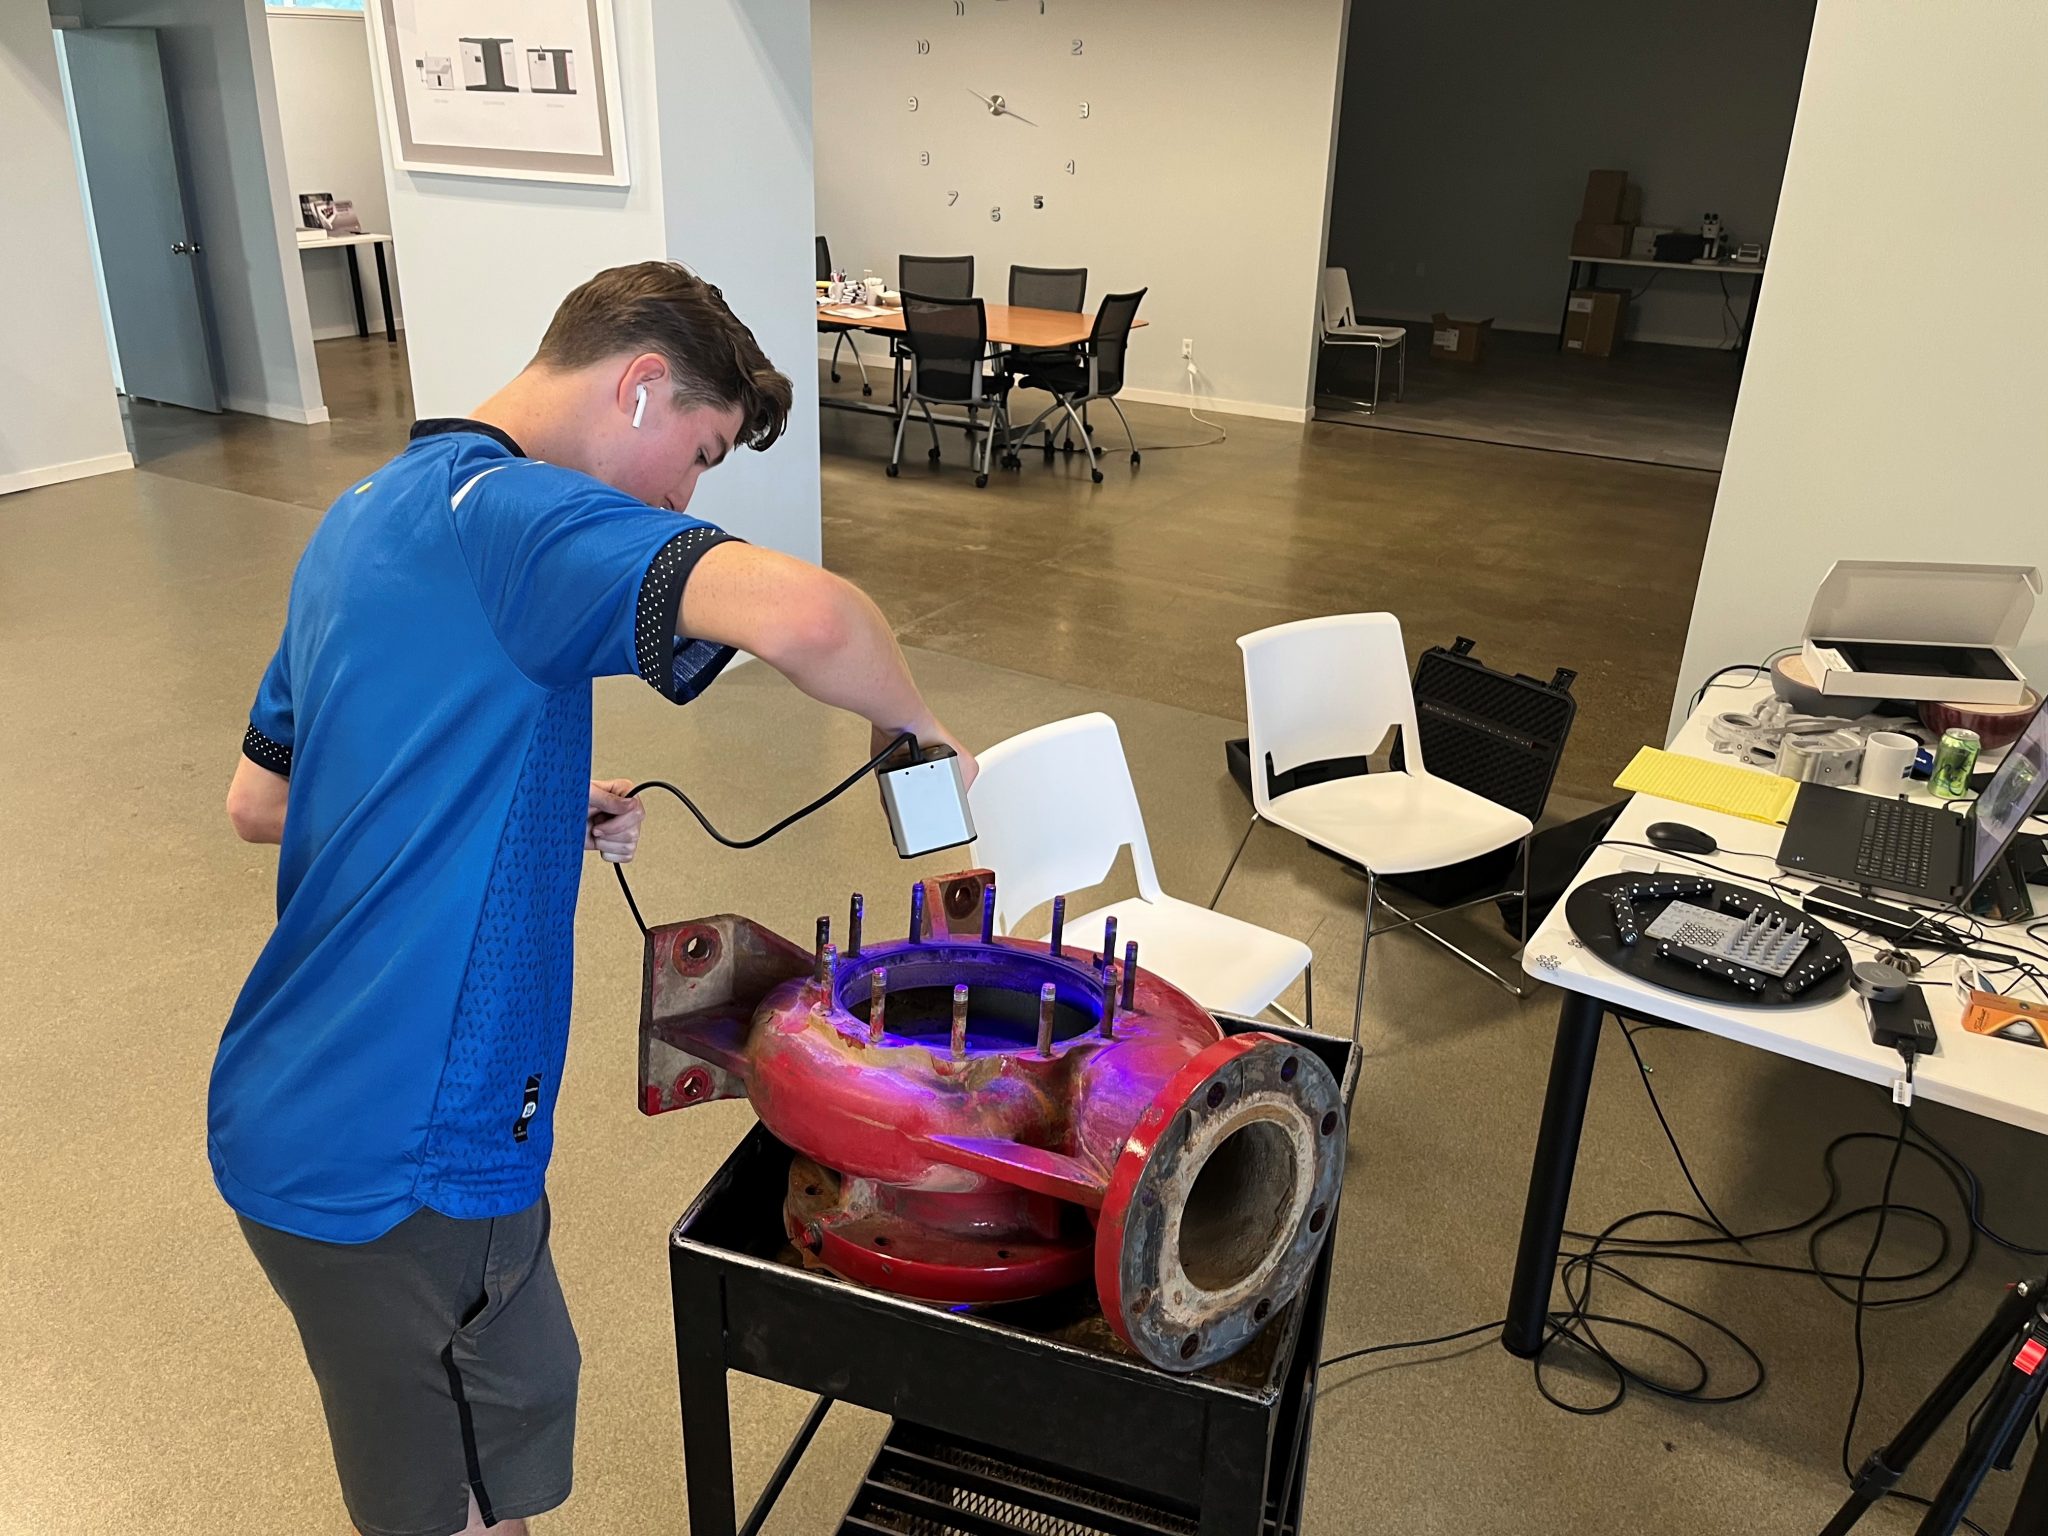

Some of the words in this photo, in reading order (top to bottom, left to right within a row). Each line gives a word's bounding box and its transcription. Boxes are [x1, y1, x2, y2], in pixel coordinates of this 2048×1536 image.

[954, 0, 965, 16] 11
[1039, 0, 1045, 15] 1
[916, 39, 930, 55] 10
[1071, 39, 1083, 56] 2
[907, 96, 919, 112] 9
[1078, 101, 1090, 119] 3
[919, 151, 930, 166] 8
[1065, 159, 1075, 175] 4
[947, 190, 959, 207] 7
[1033, 195, 1044, 210] 5
[990, 207, 1001, 222] 6
